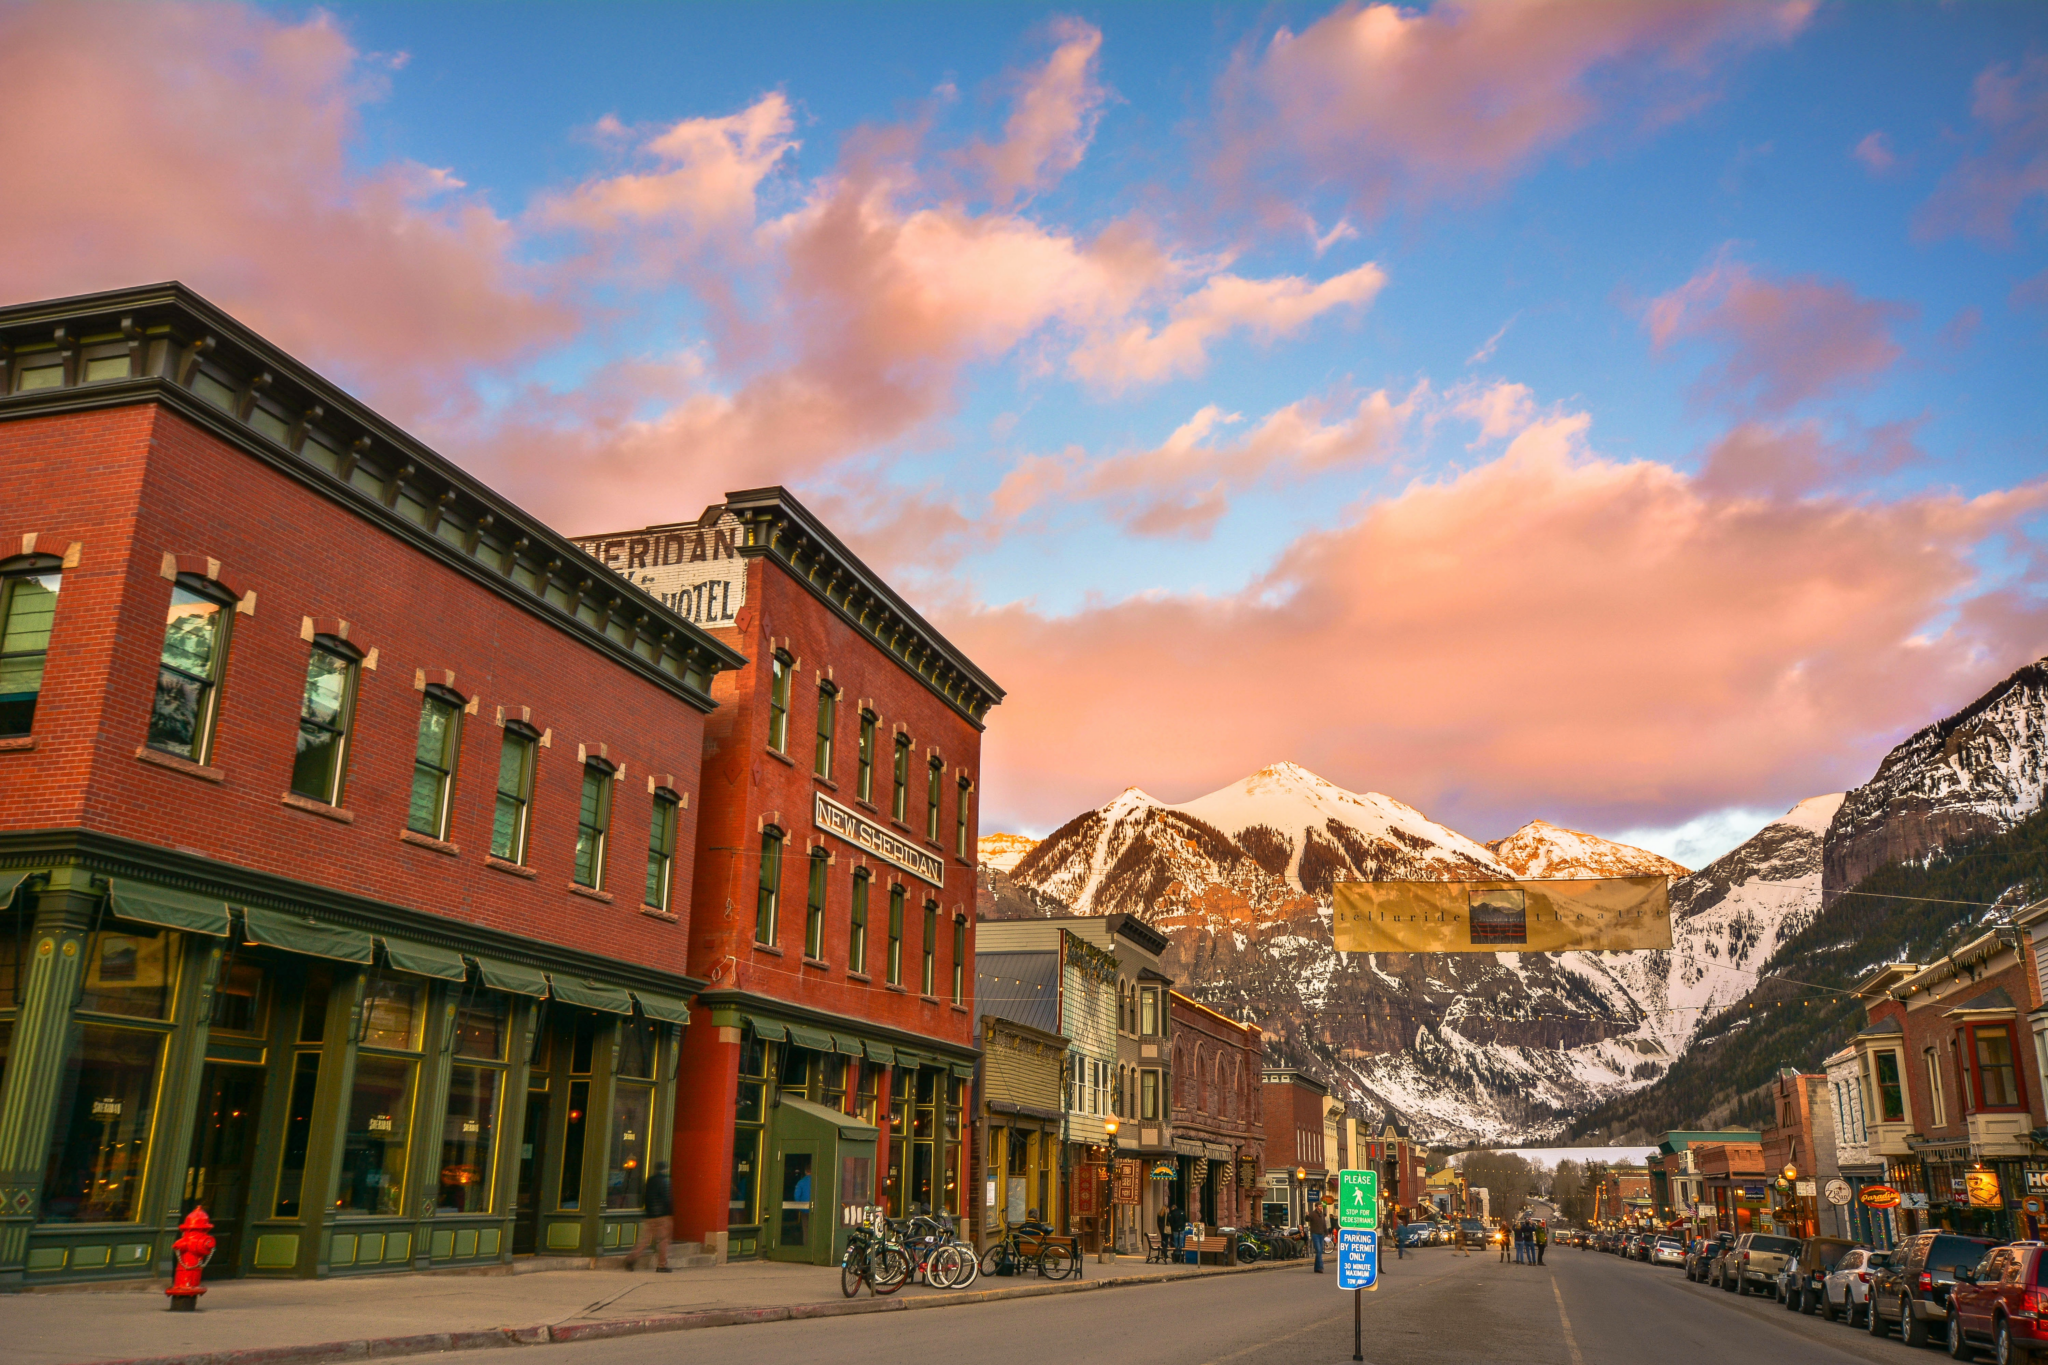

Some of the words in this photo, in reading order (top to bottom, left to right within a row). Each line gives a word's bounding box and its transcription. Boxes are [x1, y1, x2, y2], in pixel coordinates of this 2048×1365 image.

[818, 801, 856, 838] NEW
[1340, 911, 1461, 922] telluride
[1536, 909, 1664, 921] theatre
[1344, 1175, 1371, 1184] PLEASE
[1341, 1216, 1374, 1224] PEDESTRIANS
[1344, 1234, 1371, 1243] PARKING
[1351, 1244, 1375, 1252] PERMIT
[1349, 1252, 1366, 1261] ONLY
